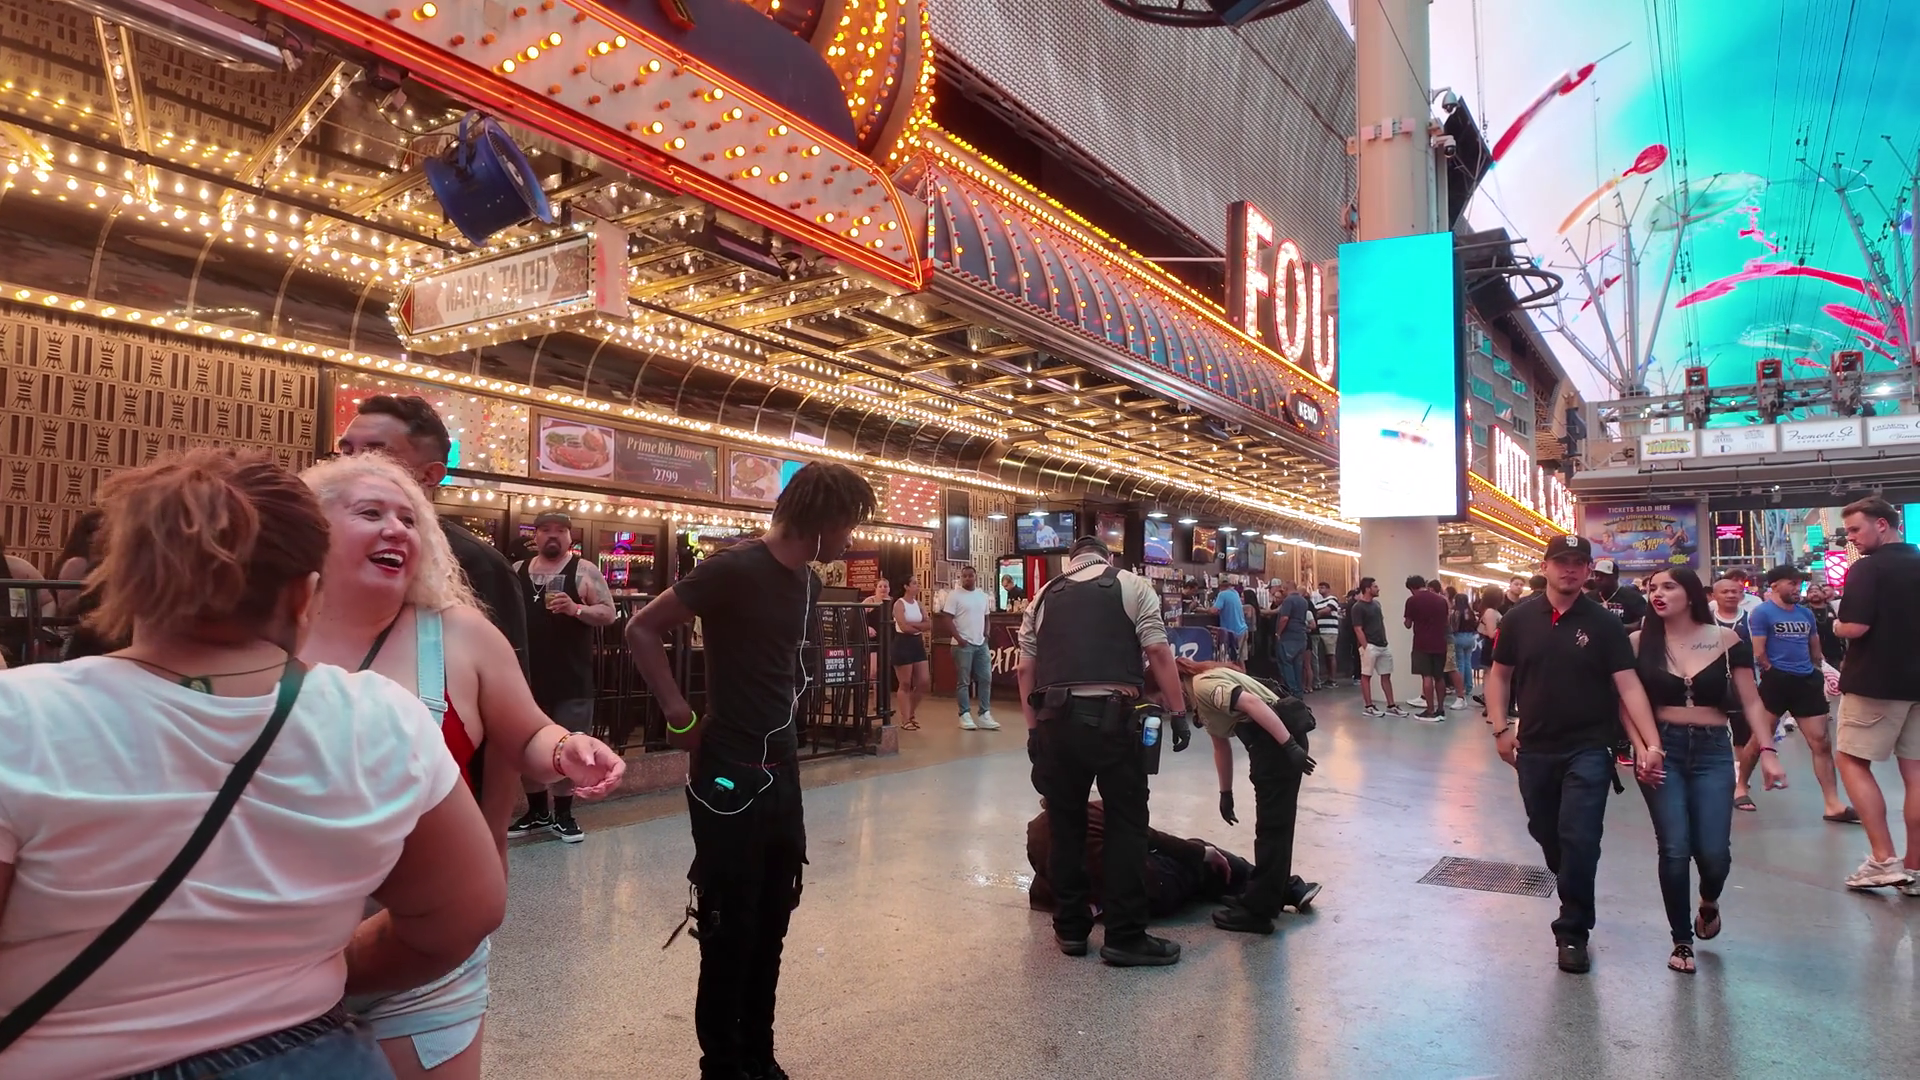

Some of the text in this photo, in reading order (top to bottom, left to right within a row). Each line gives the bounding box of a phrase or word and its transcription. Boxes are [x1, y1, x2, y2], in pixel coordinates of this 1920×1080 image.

[499, 256, 549, 297] TACO
[1245, 202, 1337, 382] FOU
[1298, 400, 1318, 425] KENO
[1786, 430, 1835, 441] Fremont
[627, 436, 657, 454] Prime
[658, 441, 673, 456] Rib
[674, 444, 705, 462] Dinner
[1691, 641, 1719, 651] Angel
